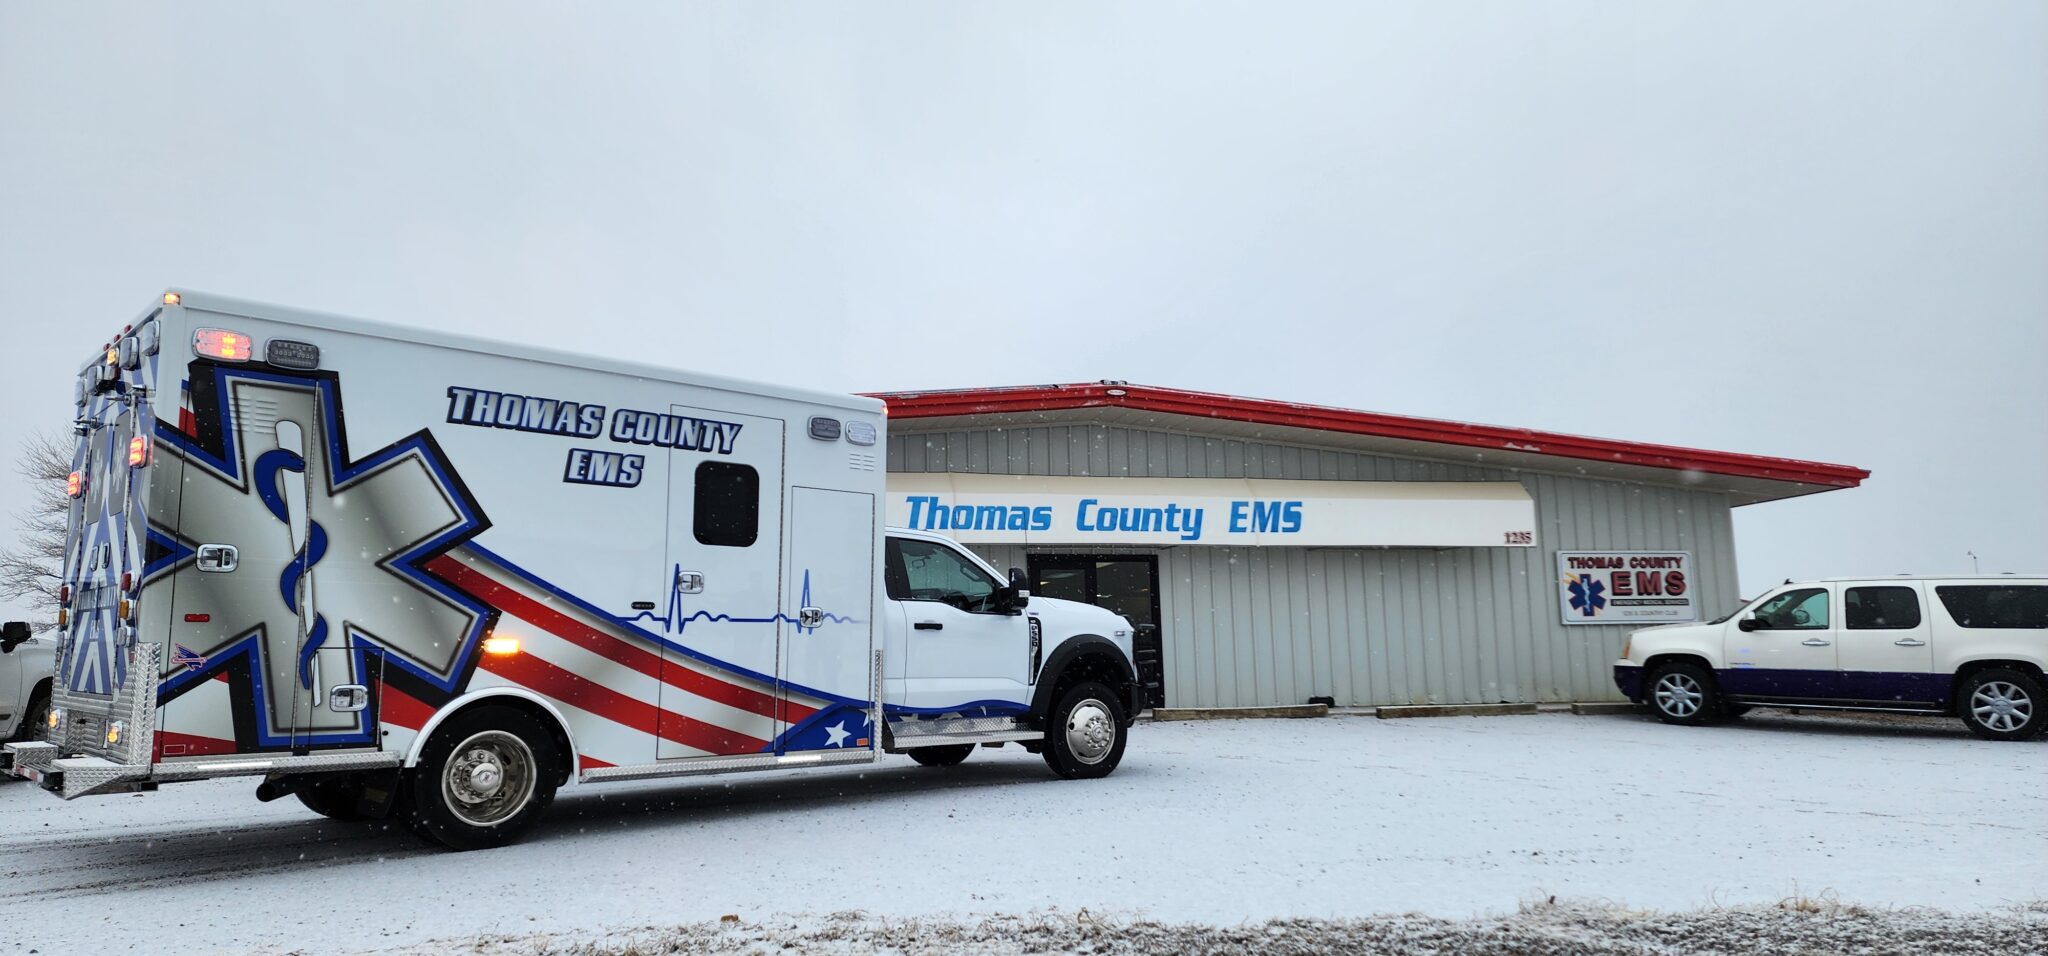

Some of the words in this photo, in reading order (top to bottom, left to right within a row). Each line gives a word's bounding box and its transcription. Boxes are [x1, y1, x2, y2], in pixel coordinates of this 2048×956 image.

[446, 386, 606, 439] THOMAS
[609, 408, 744, 454] COUNTY
[562, 448, 646, 488] EMS
[905, 496, 1052, 531] Thomas
[1076, 498, 1204, 541] County
[1228, 500, 1303, 533] EMS
[1504, 531, 1532, 544] 1235
[1567, 556, 1624, 569] THOMAS
[1629, 556, 1683, 569] COUNTY
[1610, 570, 1687, 596] EMS
